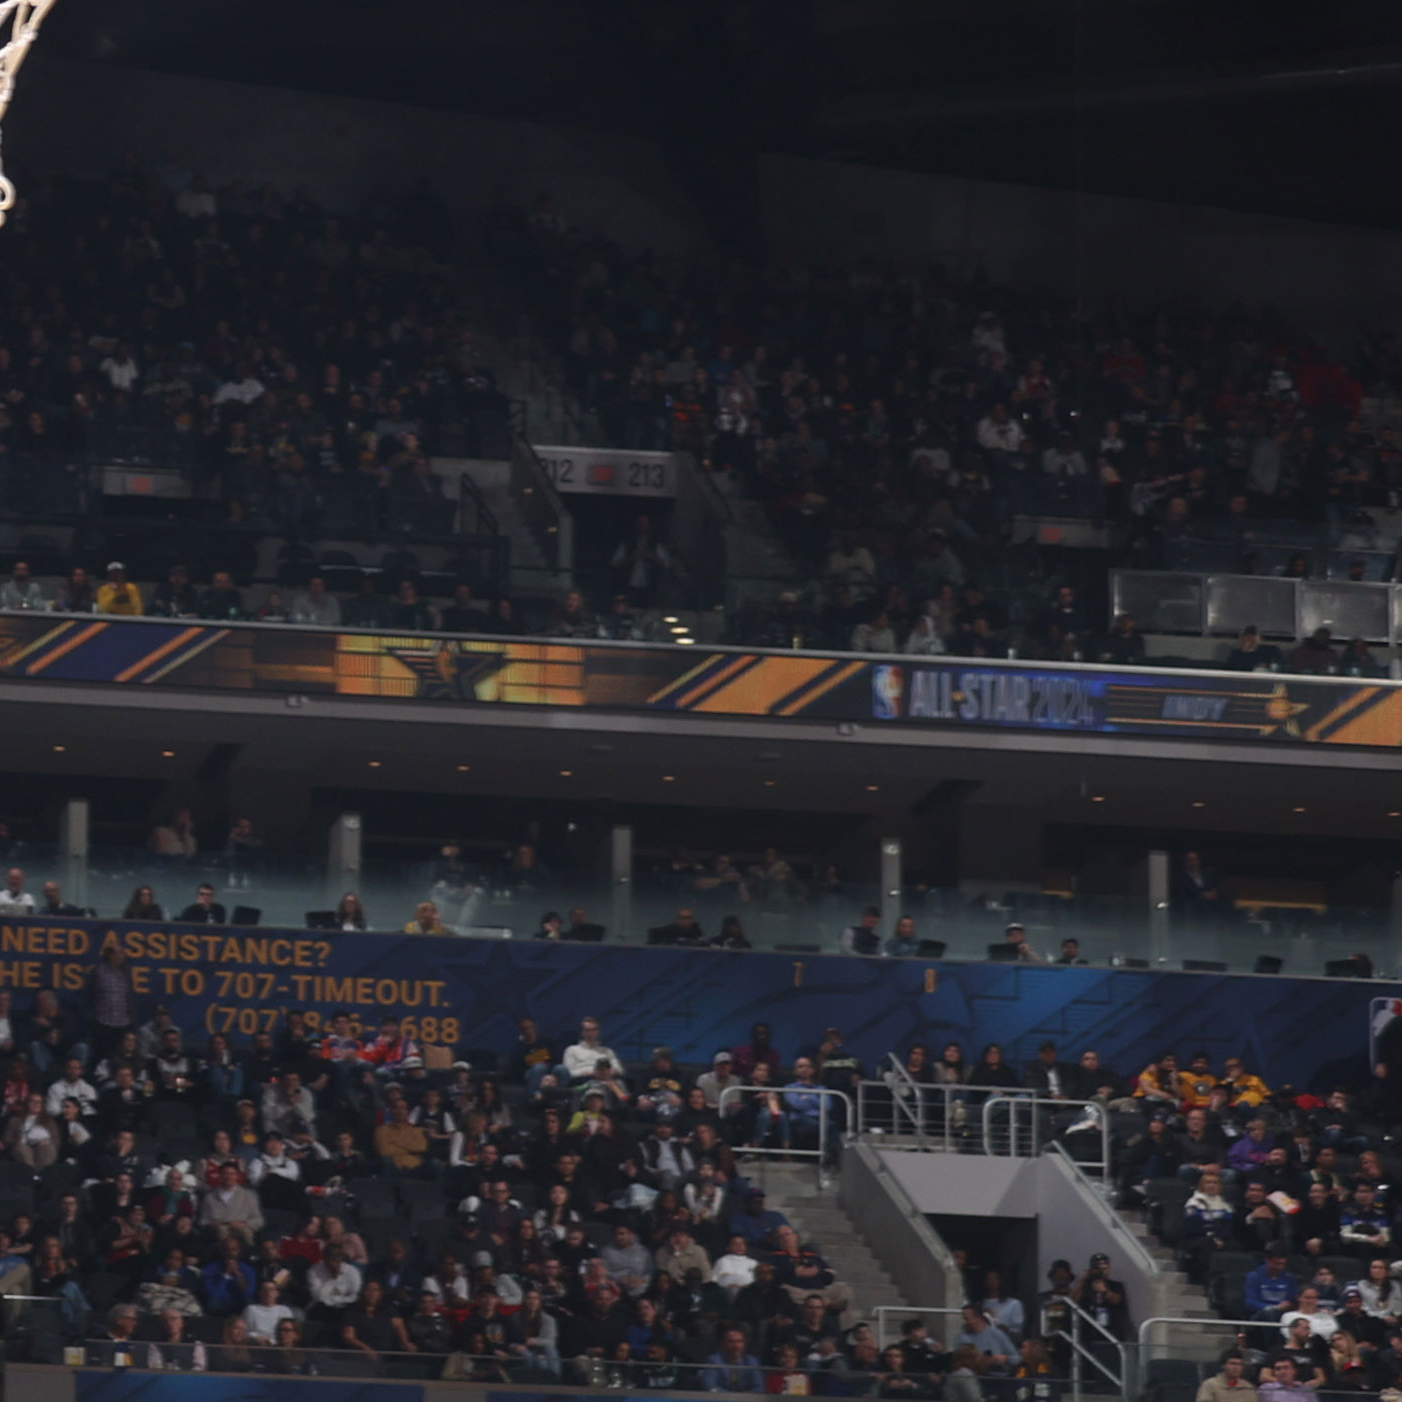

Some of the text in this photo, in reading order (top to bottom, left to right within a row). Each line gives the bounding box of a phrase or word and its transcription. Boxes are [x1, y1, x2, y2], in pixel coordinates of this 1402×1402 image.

[628, 463, 665, 488] 213
[908, 669, 1031, 720] ALL-STAR
[1, 925, 332, 968] NEED ASSISTANCE?
[52, 962, 152, 994] ISE
[157, 968, 204, 996] TO
[215, 970, 452, 1008] 707-TIMEOUT.
